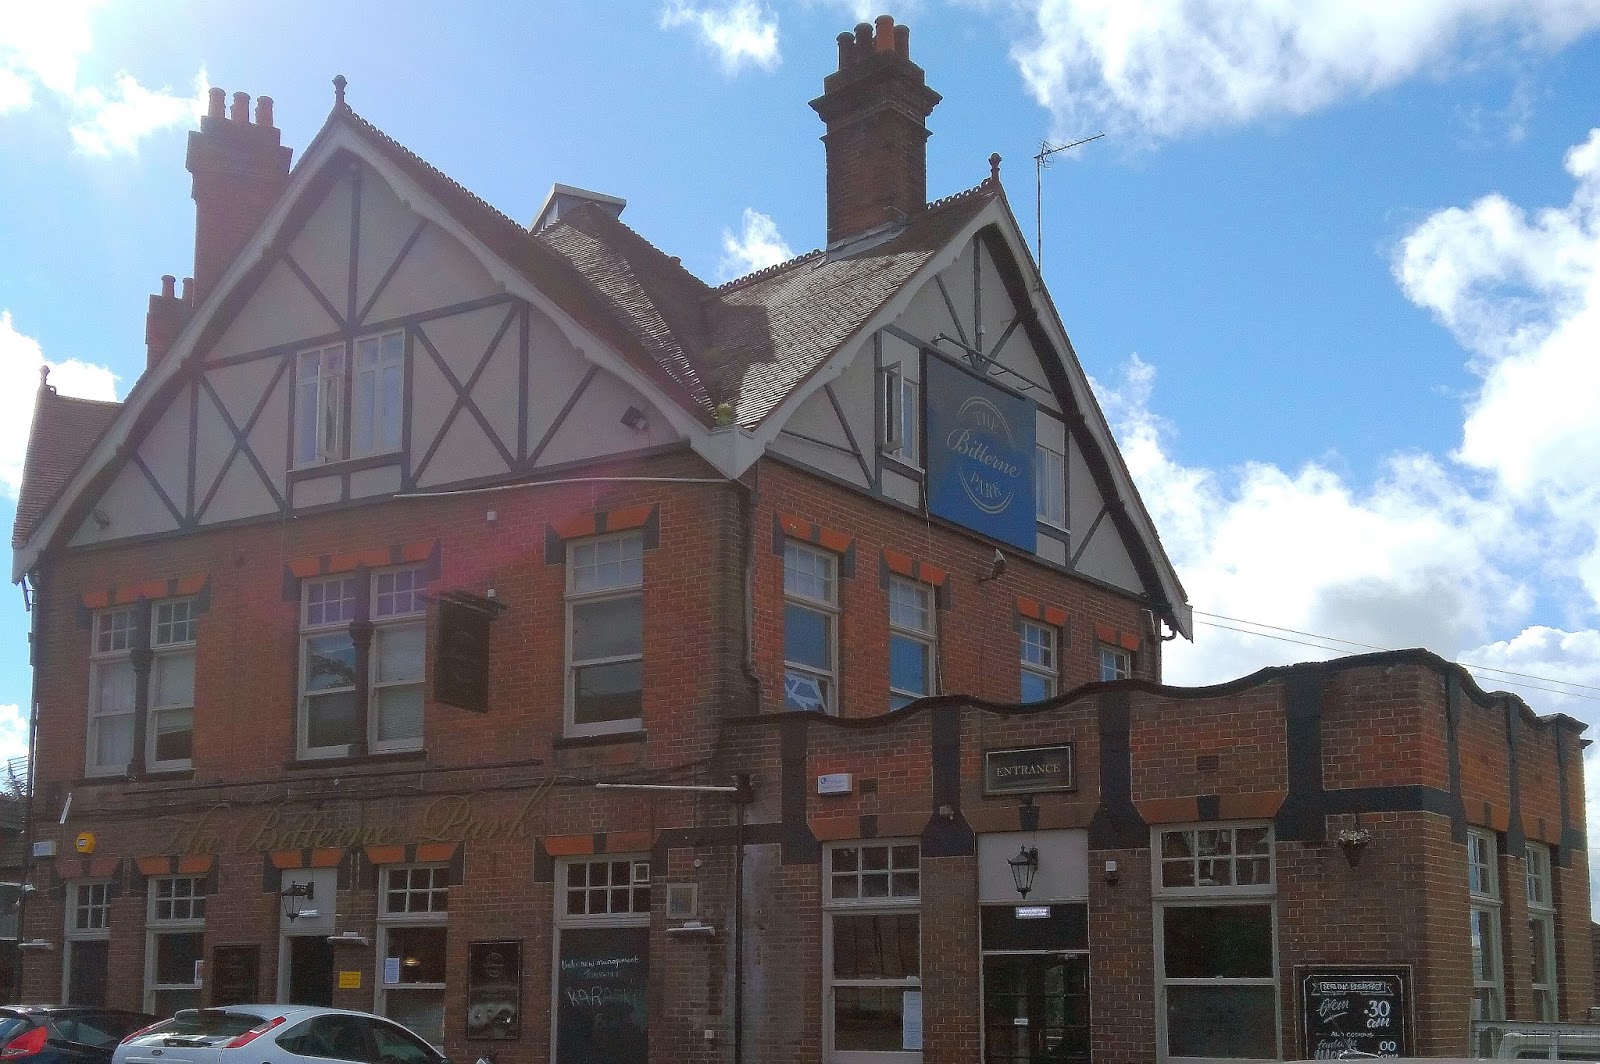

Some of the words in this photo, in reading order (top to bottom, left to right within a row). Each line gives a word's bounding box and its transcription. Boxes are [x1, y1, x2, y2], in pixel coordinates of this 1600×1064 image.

[973, 410, 999, 433] THE
[947, 428, 1022, 478] Bitterne
[970, 471, 1002, 499] PARK
[996, 763, 1061, 777] ENTRANCE
[158, 802, 232, 857] The
[235, 791, 405, 853] Bitterne
[414, 774, 559, 842] Park
[596, 955, 639, 969] management
[1366, 1017, 1390, 1029] am
